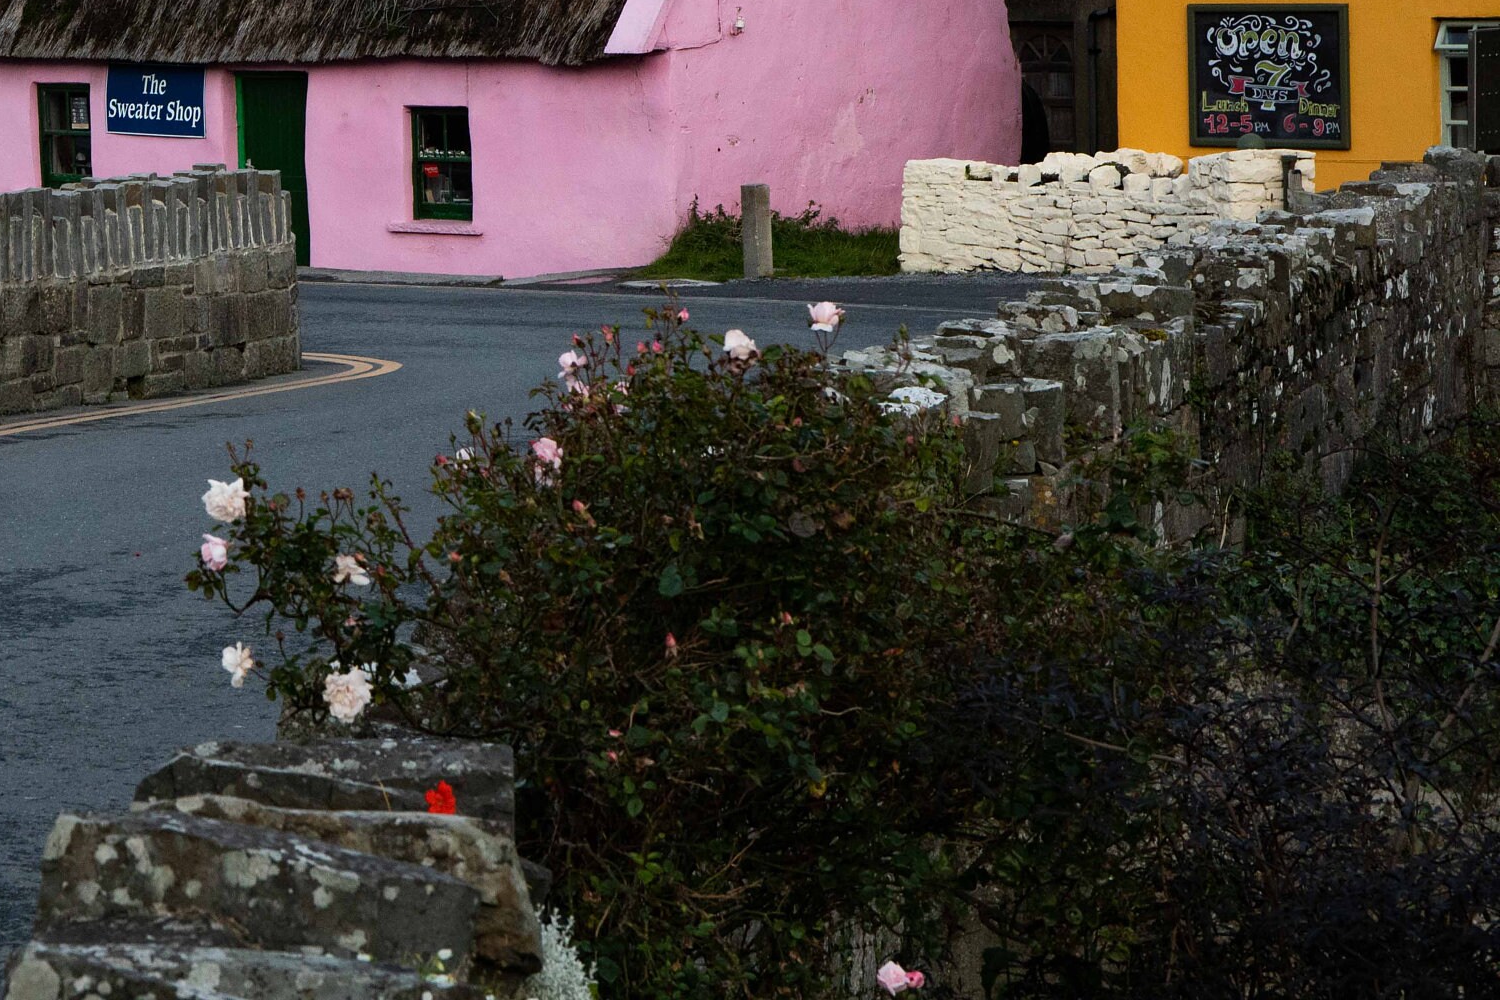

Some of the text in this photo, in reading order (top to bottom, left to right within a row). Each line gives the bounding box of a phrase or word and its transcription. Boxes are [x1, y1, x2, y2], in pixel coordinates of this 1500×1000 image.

[142, 73, 167, 95] The
[1252, 88, 1288, 101] DAYS
[1255, 60, 1292, 111] 7
[1202, 91, 1249, 112] Lunch
[1299, 98, 1340, 117] Dinner
[108, 99, 163, 120] Sweater
[166, 100, 201, 128] Shop
